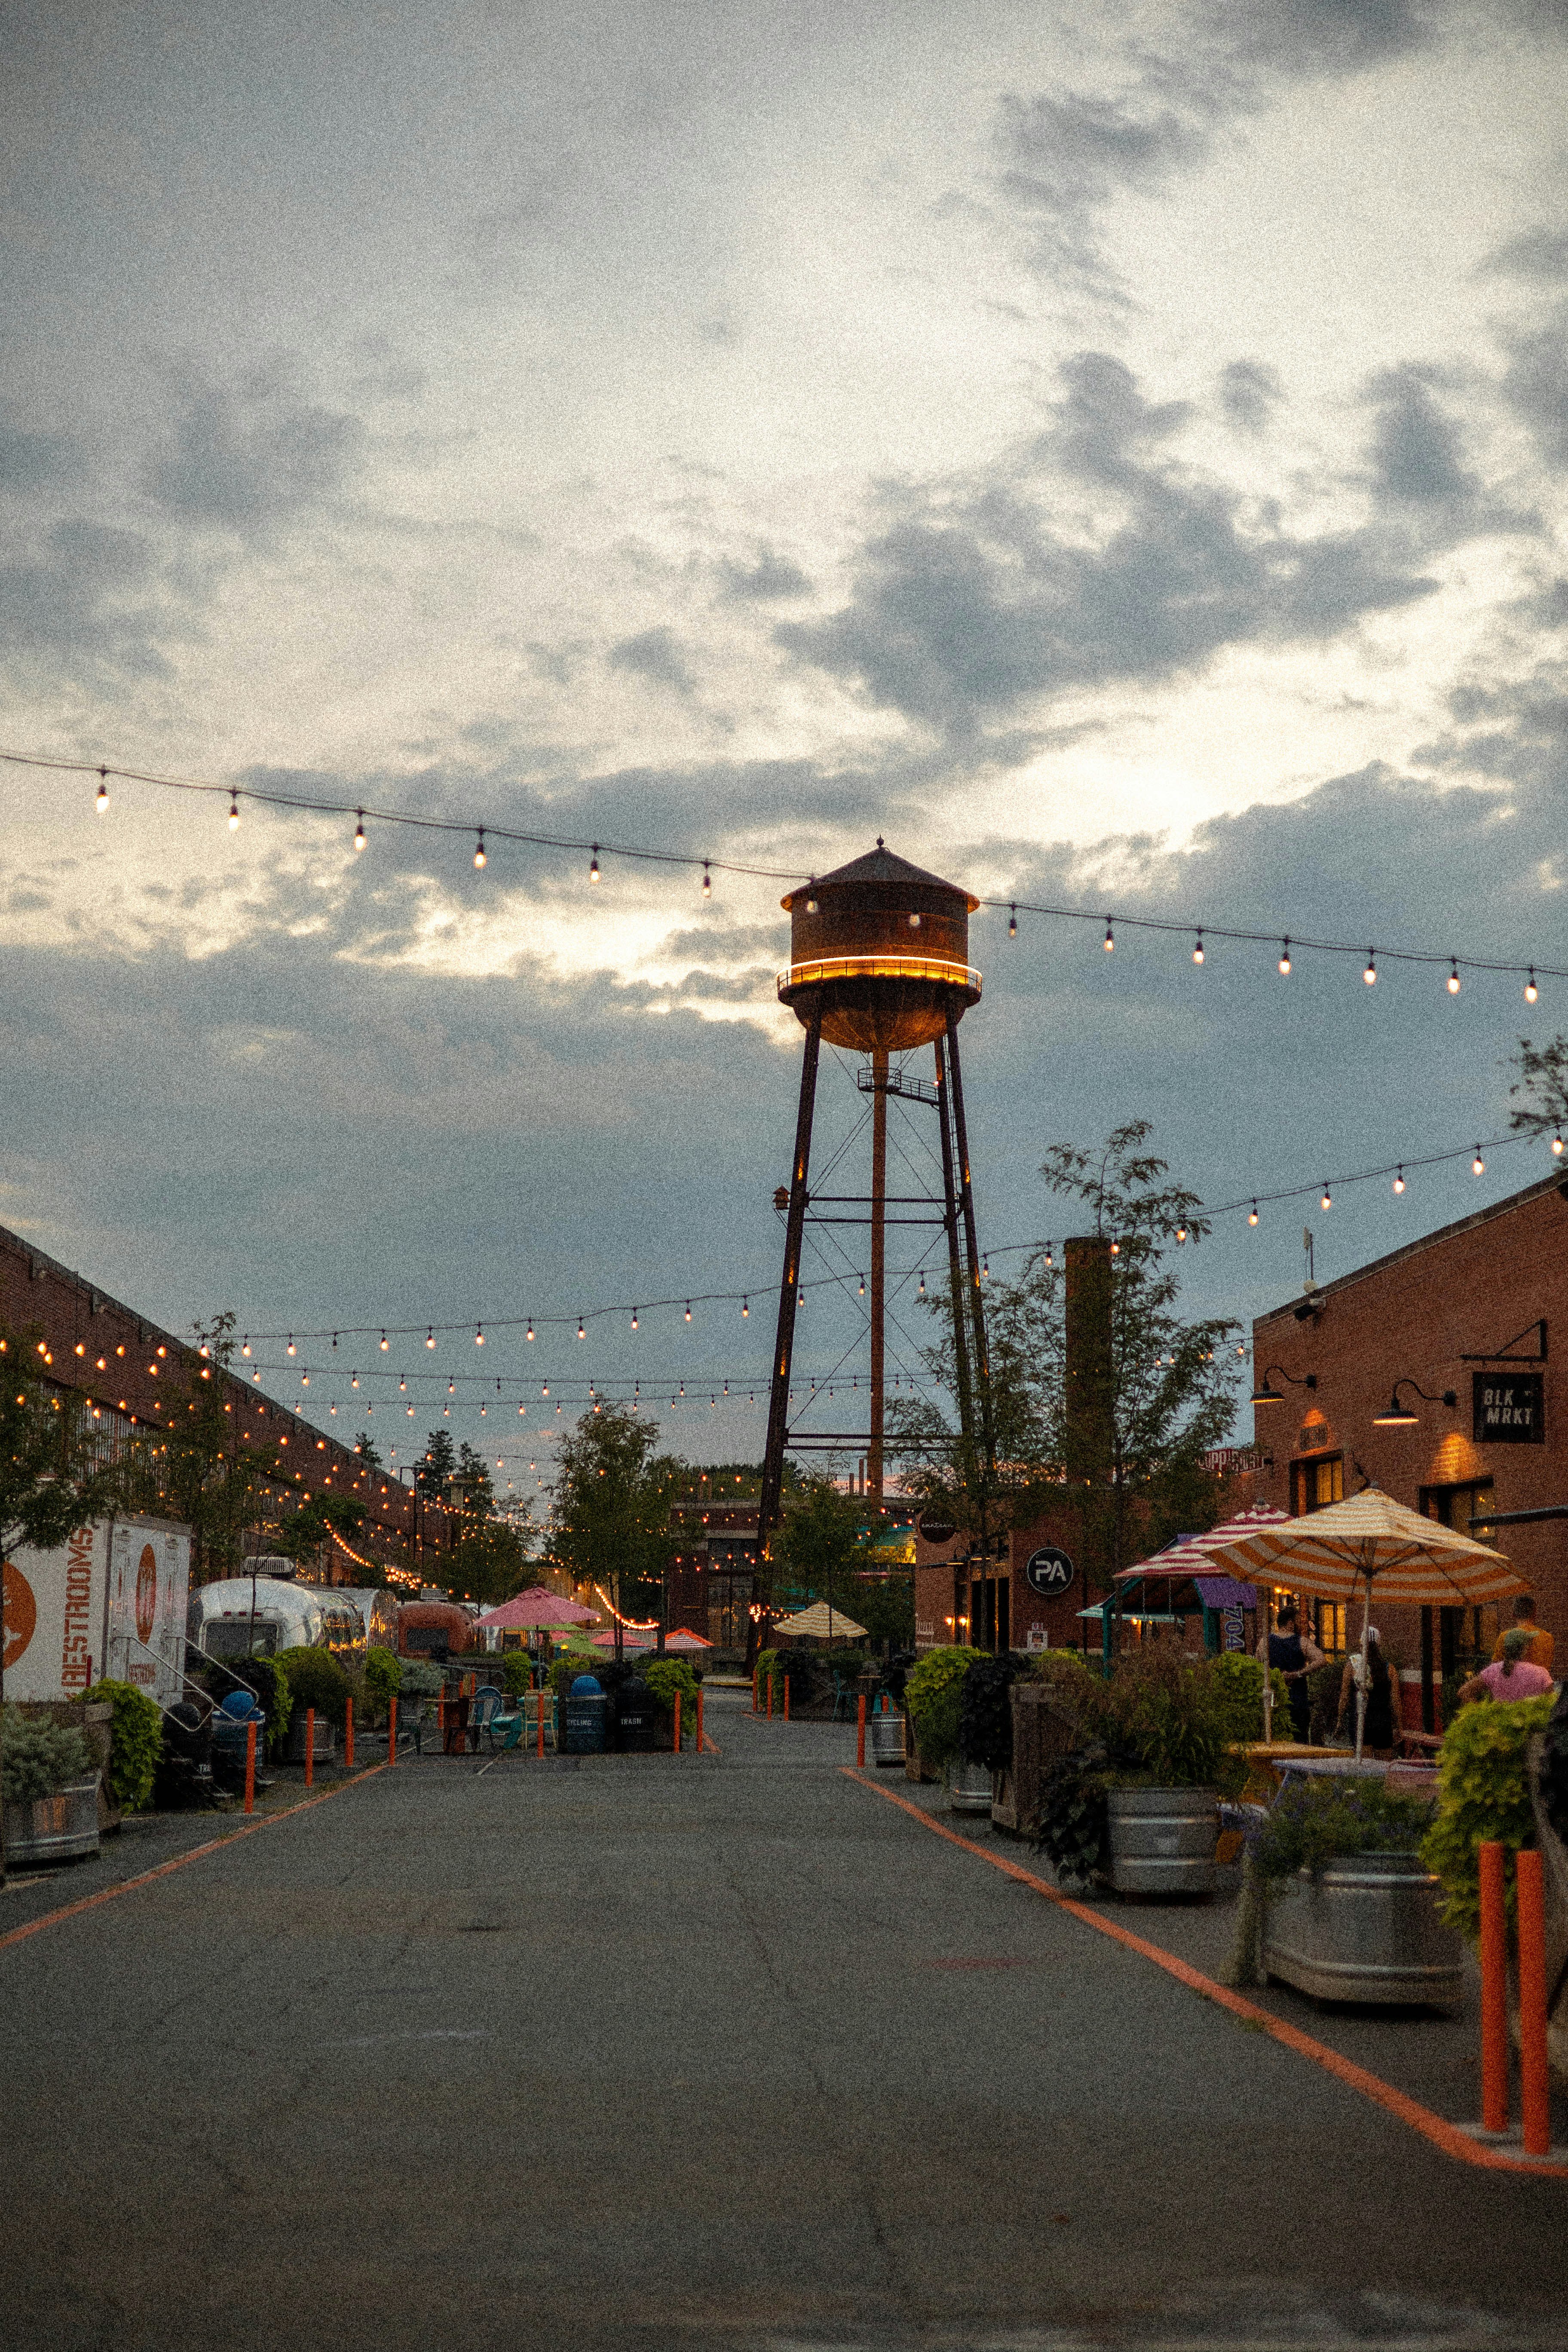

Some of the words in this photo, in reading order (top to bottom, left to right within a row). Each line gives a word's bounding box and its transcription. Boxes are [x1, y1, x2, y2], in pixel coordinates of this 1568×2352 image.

[1484, 1389, 1514, 1406] BLK
[1487, 1407, 1533, 1424] MRKT
[1035, 1560, 1067, 1582] PA
[61, 1528, 93, 1687] RESTROOMS
[1224, 1606, 1245, 1651] 704
[621, 1718, 642, 1726] TRASH
